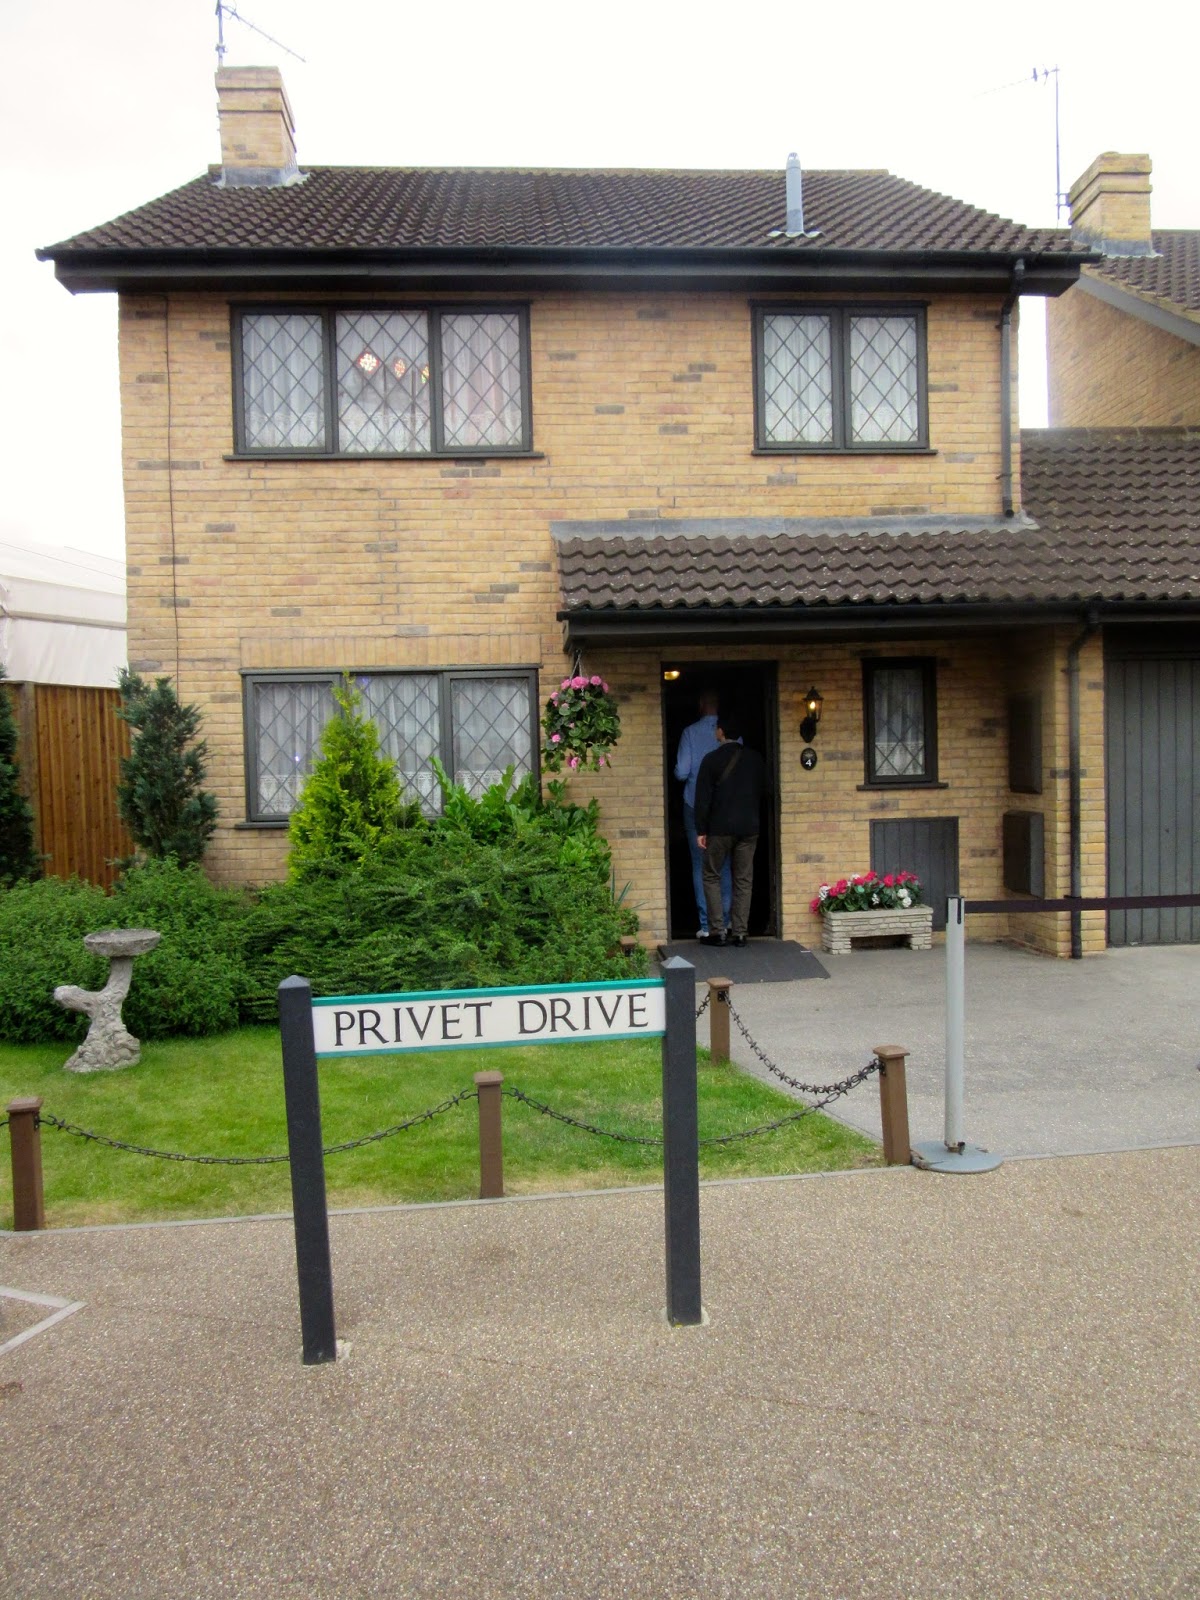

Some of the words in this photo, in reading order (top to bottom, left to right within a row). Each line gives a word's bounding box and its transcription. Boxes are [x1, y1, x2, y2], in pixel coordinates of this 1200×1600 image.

[805, 759, 812, 767] 4
[334, 1001, 493, 1047] PRIVET
[517, 992, 649, 1035] DRIVE
